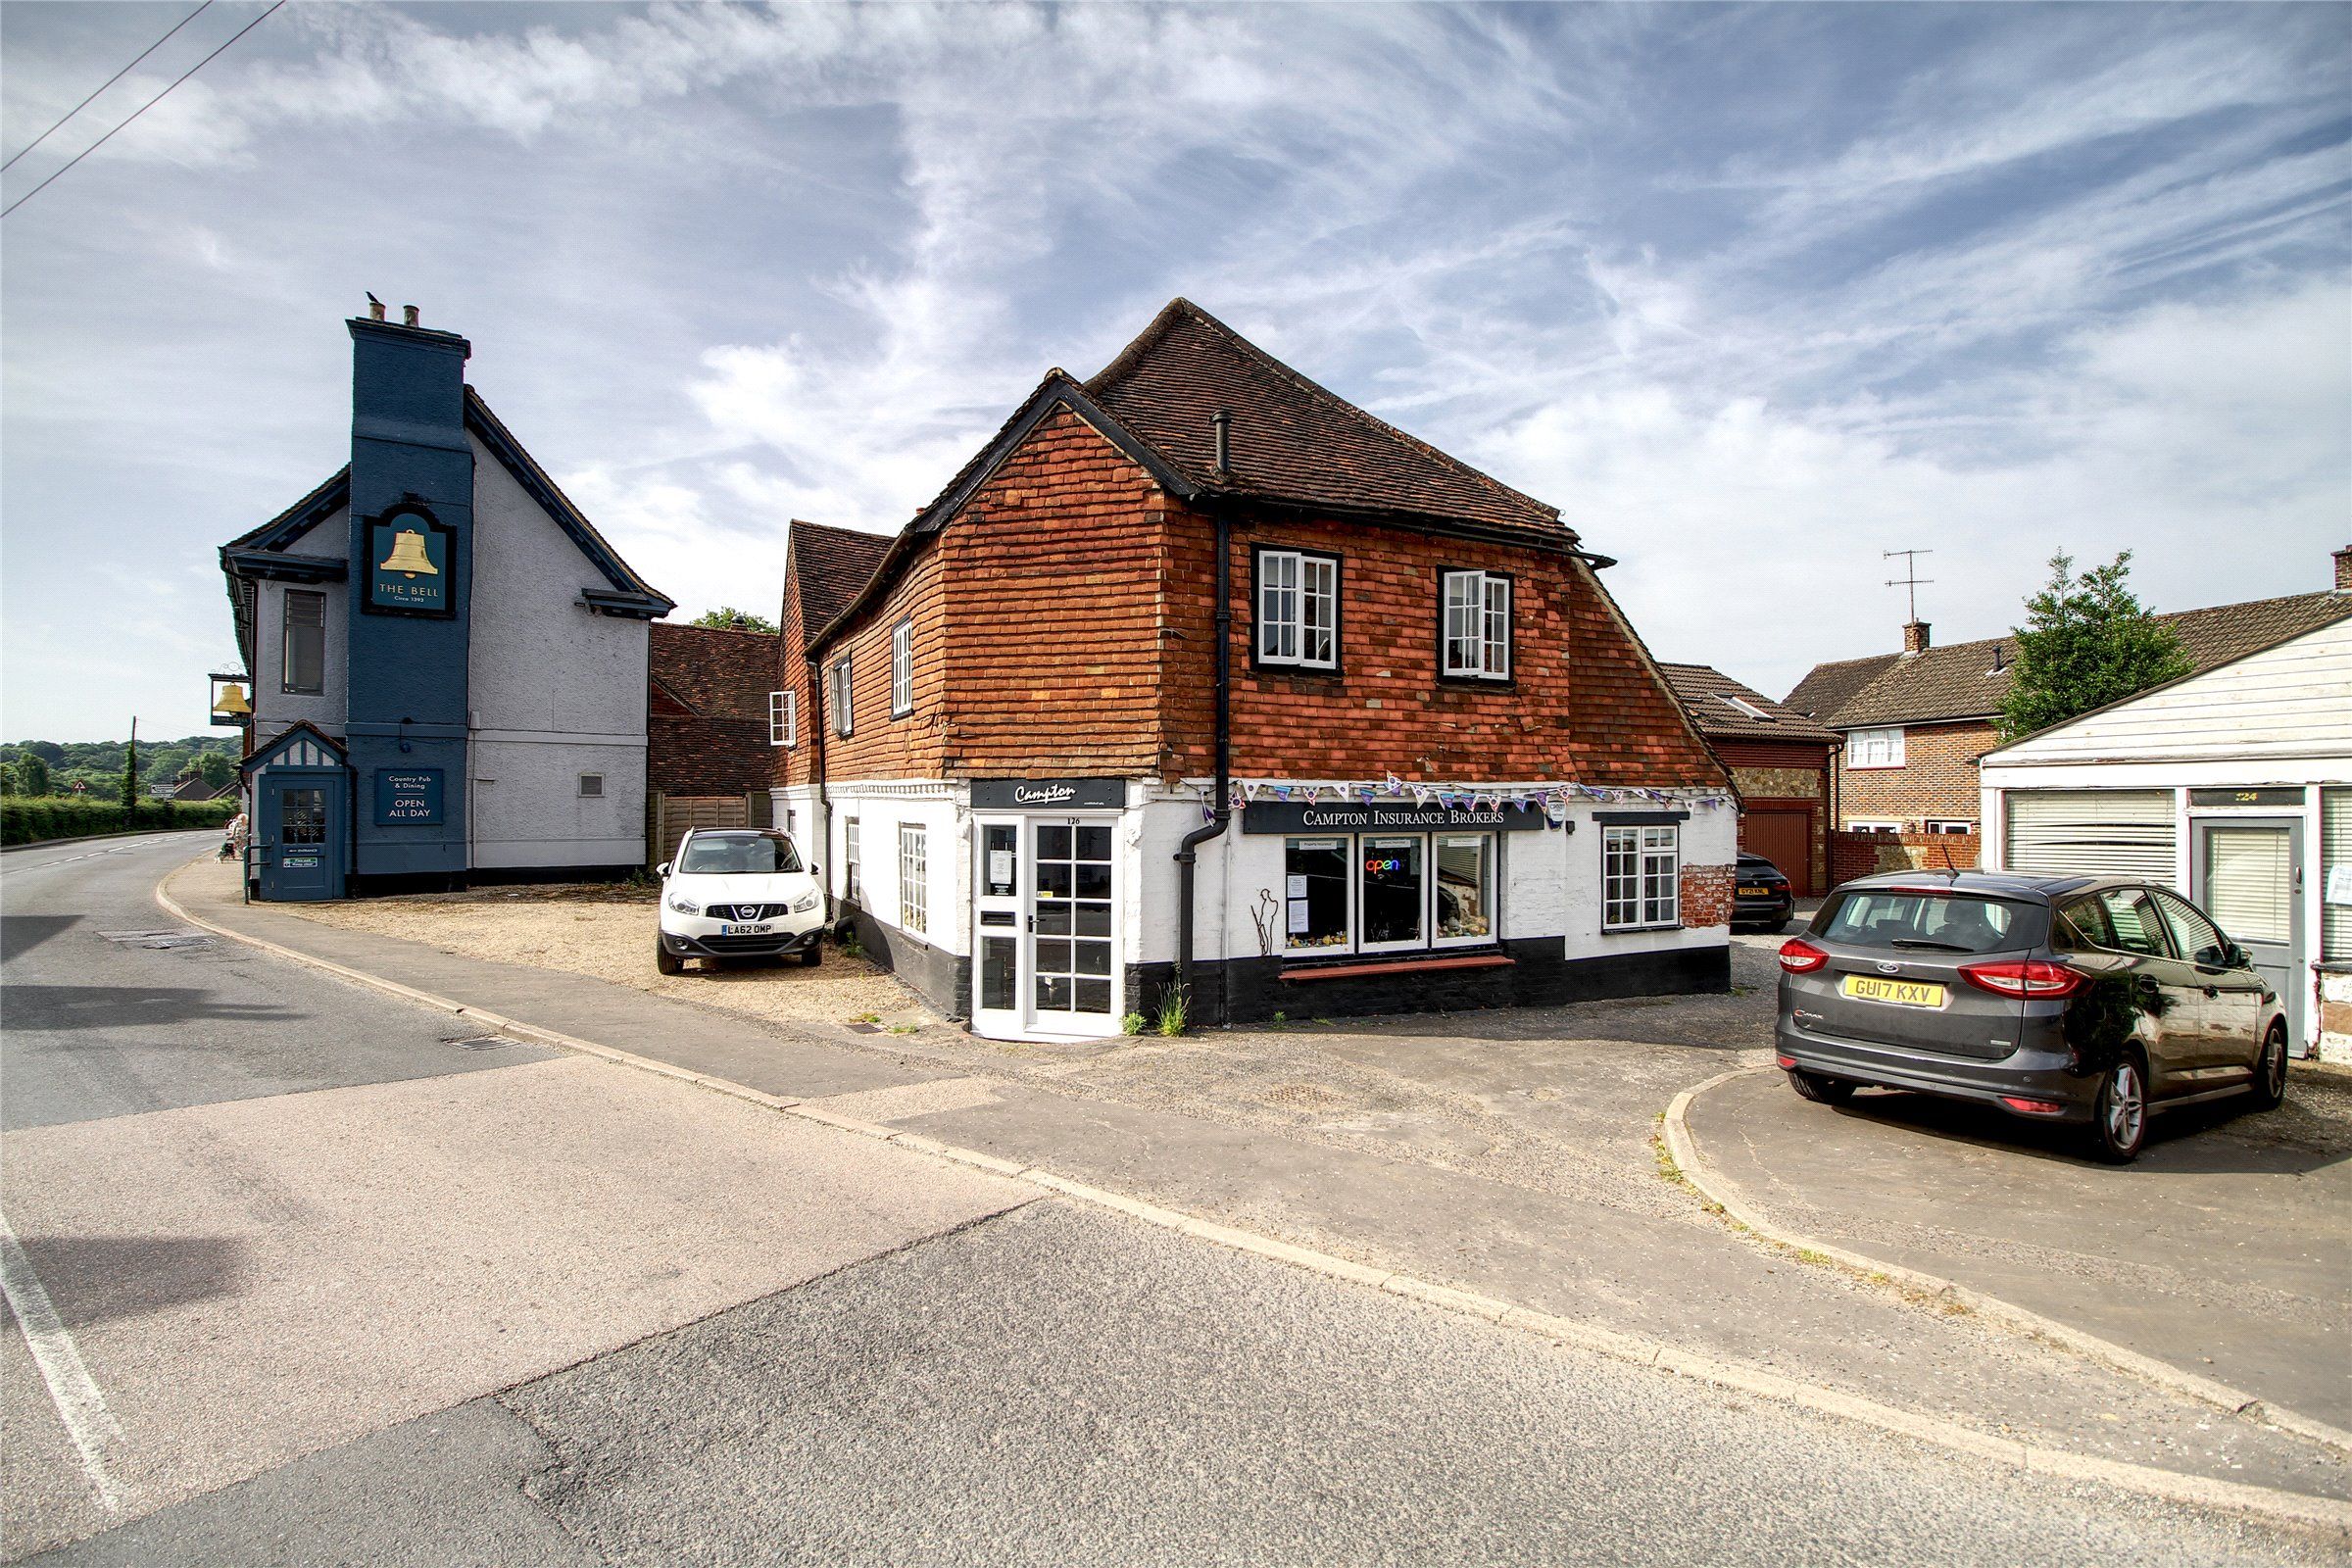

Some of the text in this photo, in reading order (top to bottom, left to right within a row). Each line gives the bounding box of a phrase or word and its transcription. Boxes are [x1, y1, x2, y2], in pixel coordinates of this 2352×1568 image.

[379, 583, 438, 597] THE BELL
[1014, 783, 1076, 805] Campton
[395, 799, 425, 808] OPEN
[410, 808, 431, 817] DAY
[1302, 809, 1504, 826] CAMPTON INSURANCE BROKERS
[1067, 816, 1081, 825] 126
[1365, 859, 1399, 875] open
[727, 925, 772, 934] LA62 OMP
[1855, 980, 1931, 1003] GU17 KXV
